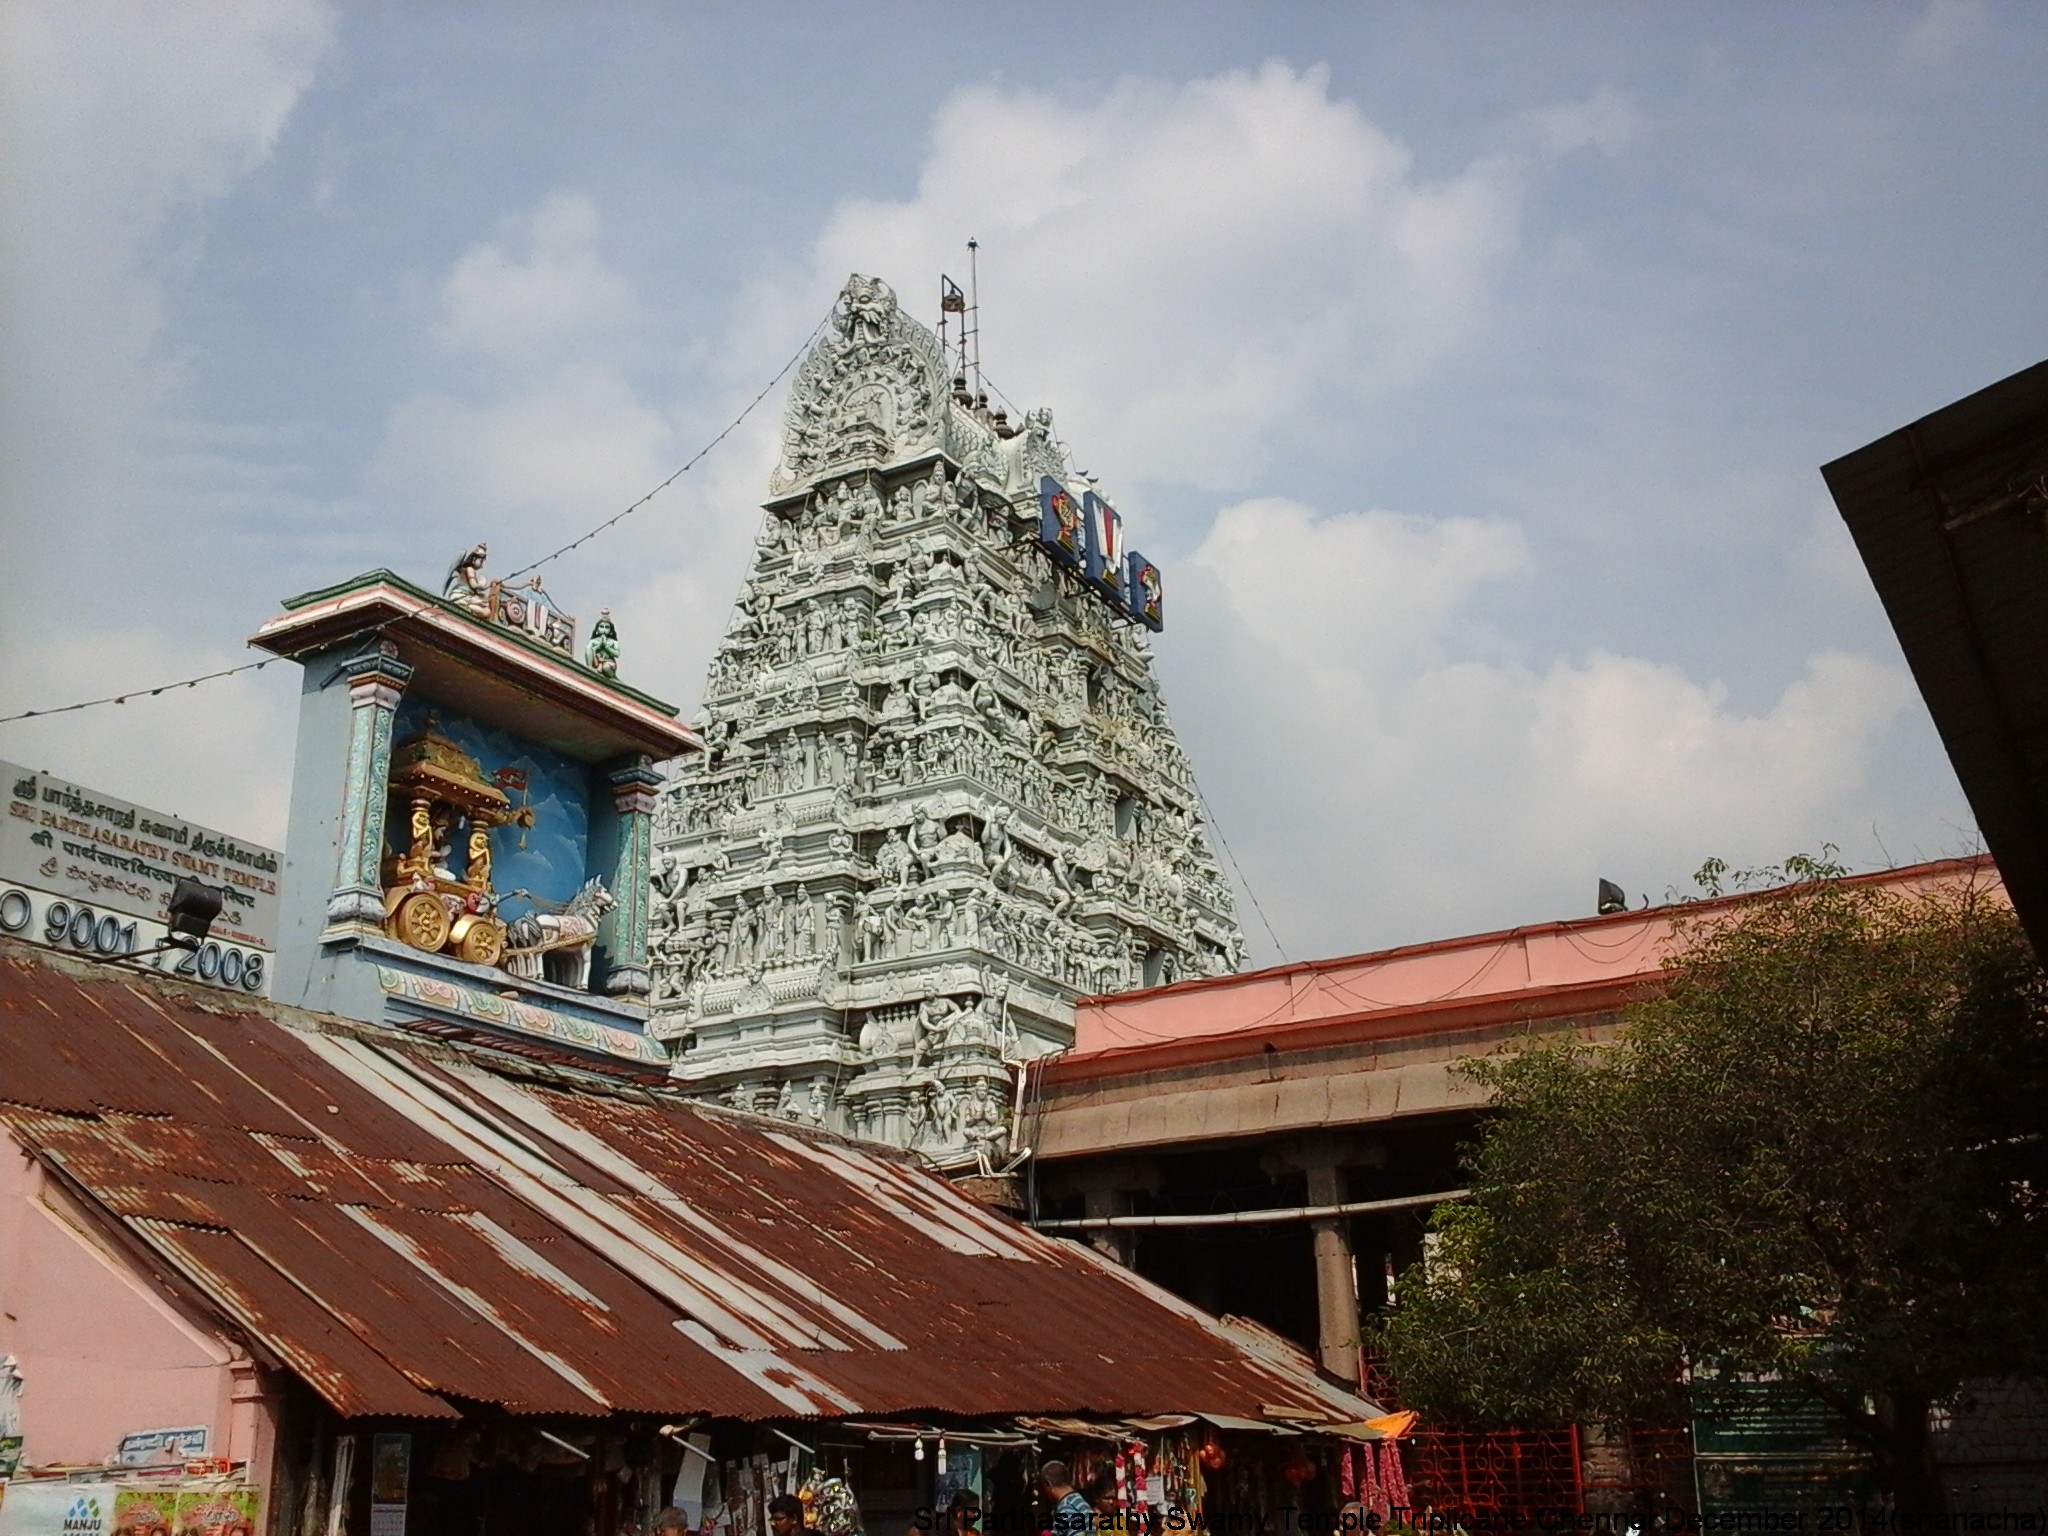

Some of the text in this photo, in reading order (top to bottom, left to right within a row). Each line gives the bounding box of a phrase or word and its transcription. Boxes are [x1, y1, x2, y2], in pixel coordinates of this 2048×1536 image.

[47, 901, 138, 953] 9001
[176, 935, 264, 991] 2008
[63, 1519, 101, 1531] MANJU
